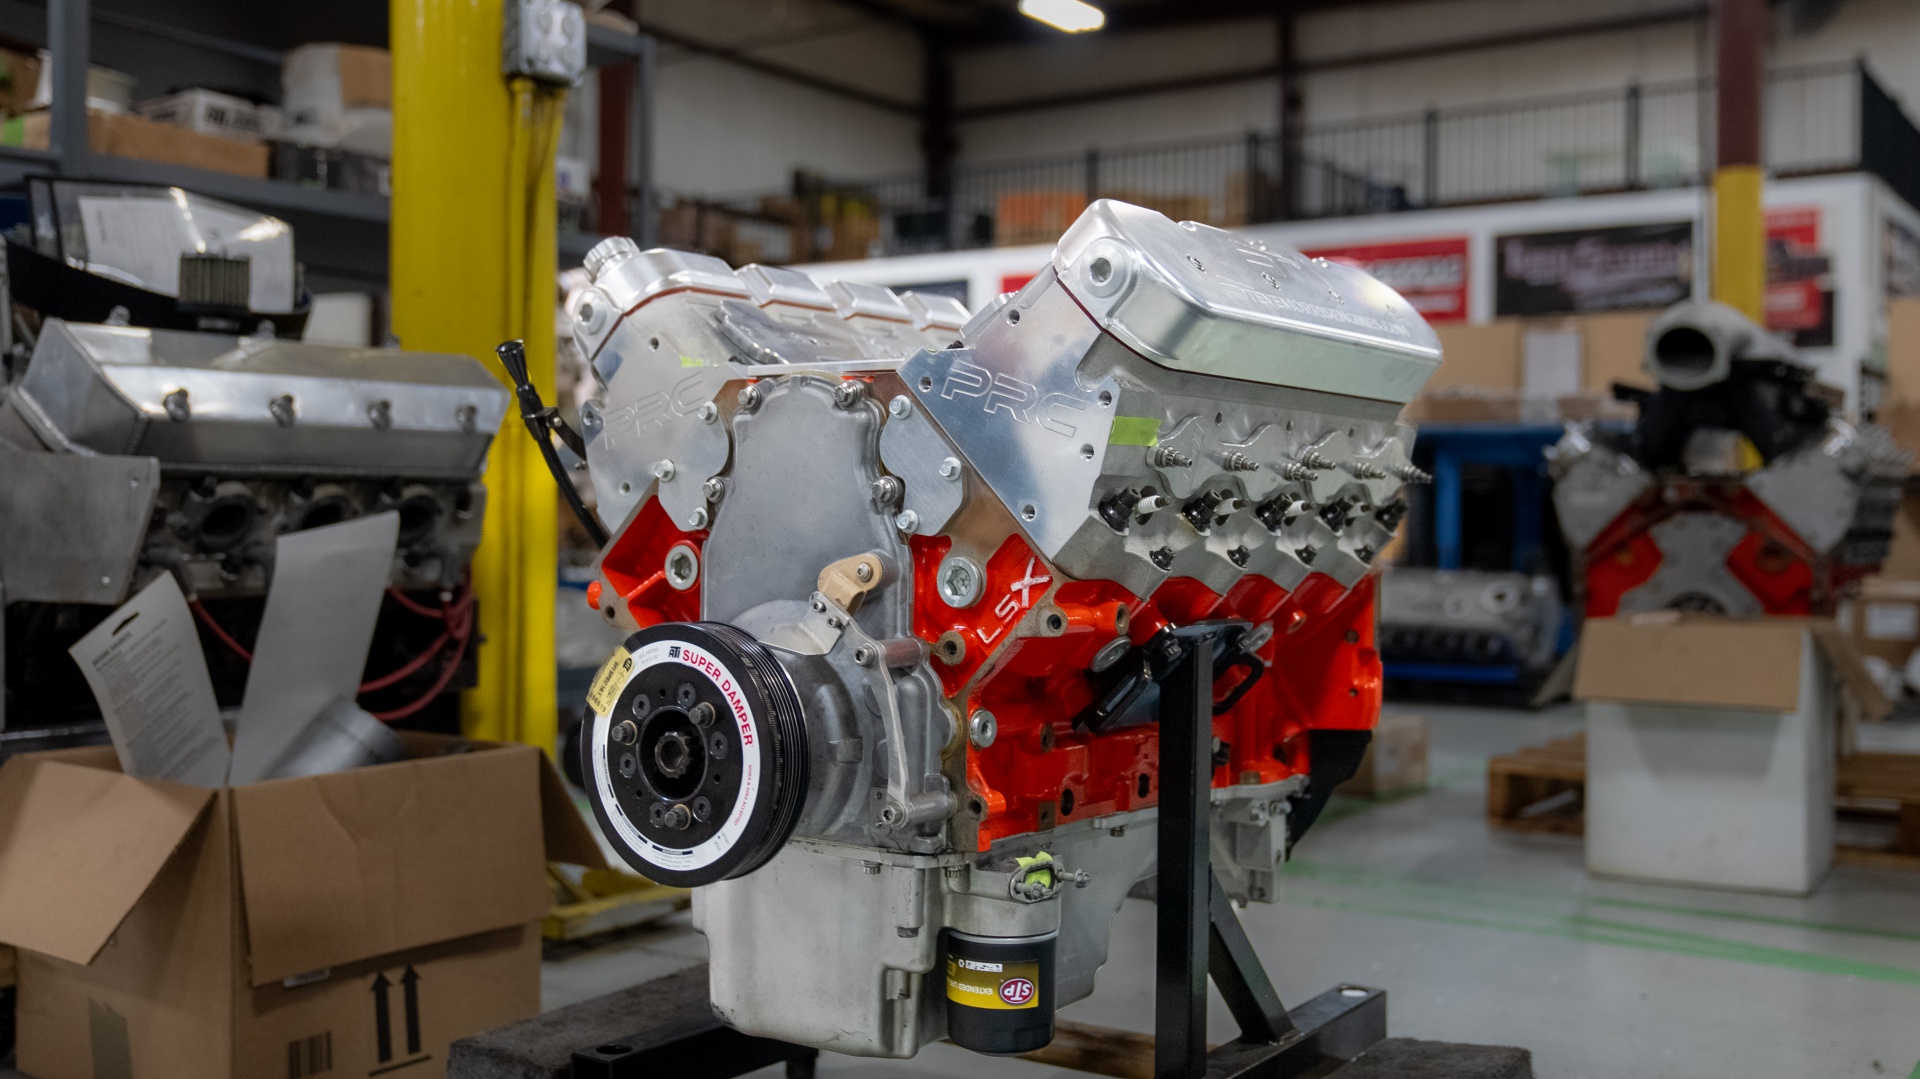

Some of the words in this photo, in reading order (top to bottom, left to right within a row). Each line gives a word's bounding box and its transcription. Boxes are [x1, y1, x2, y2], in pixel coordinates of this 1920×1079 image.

[603, 371, 705, 450] PRC
[941, 360, 1087, 438] PRC
[976, 556, 1051, 643] LSX
[669, 646, 681, 658] ATI
[682, 649, 722, 681] SUPER
[721, 679, 754, 746] DAMPER
[734, 801, 747, 826] ACCEPTED
[958, 983, 993, 995] EXTENDED
[1003, 982, 1031, 1001] STP
